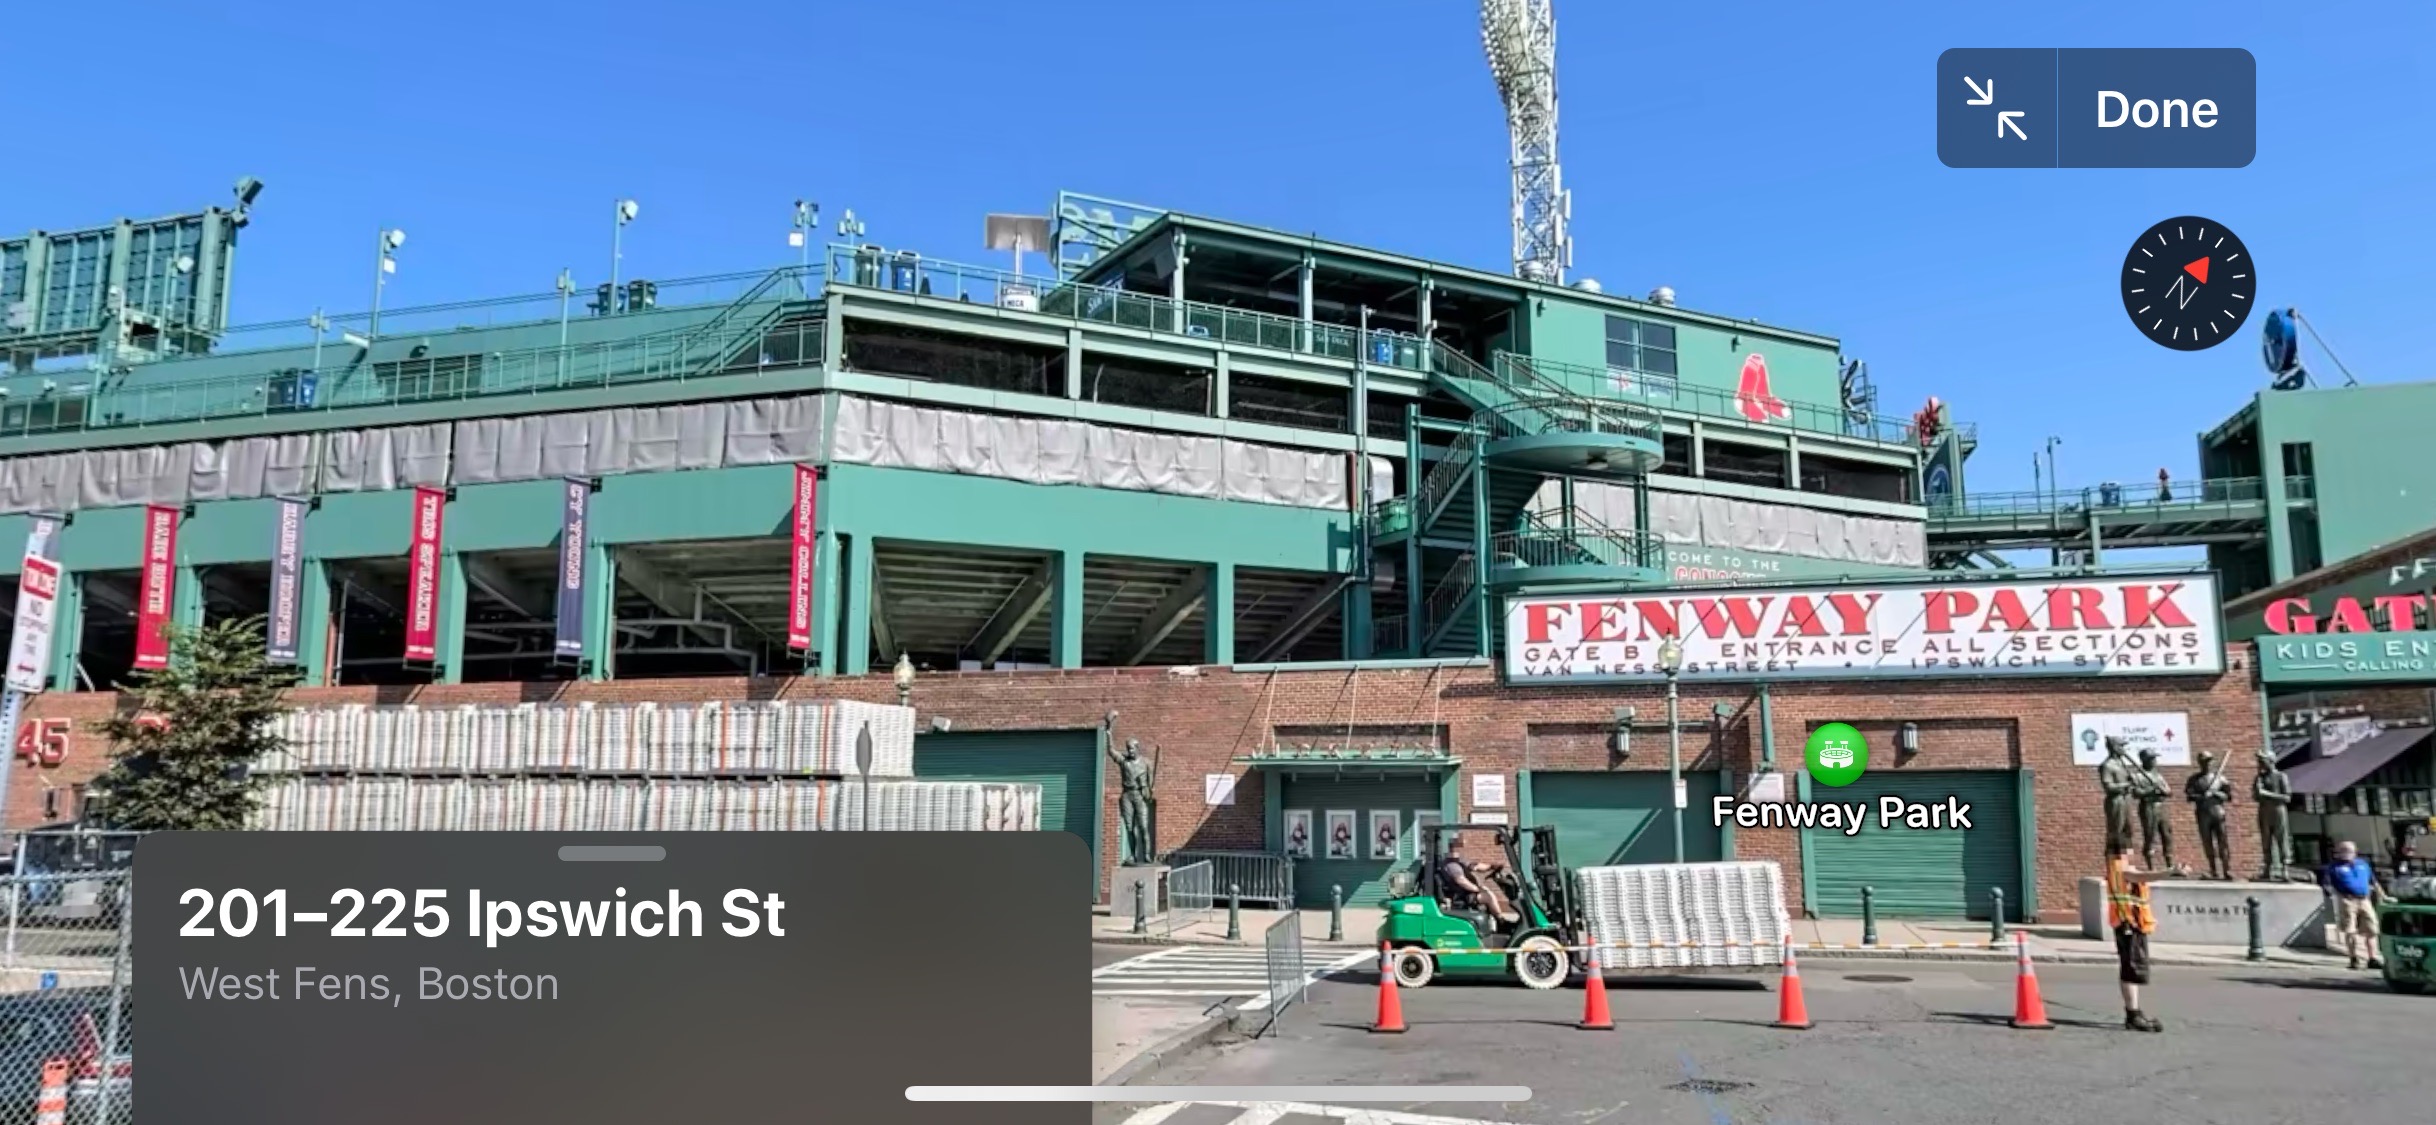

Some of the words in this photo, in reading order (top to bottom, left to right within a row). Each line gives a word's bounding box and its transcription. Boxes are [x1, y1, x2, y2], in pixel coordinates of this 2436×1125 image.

[1722, 556, 1742, 567] TO
[1752, 559, 1781, 572] THE
[1524, 592, 1884, 644] FENWAY
[1921, 583, 2197, 634] PARK
[2264, 593, 2436, 635] GAT
[1525, 646, 1601, 662] GATE
[1625, 645, 1640, 660] B
[1721, 639, 1898, 658] ENTRANCE
[1922, 637, 1985, 654] ALL
[2011, 632, 2199, 652] SECTIONS
[2276, 642, 2359, 660] KIDS
[2385, 640, 2436, 657] EN
[1525, 665, 1573, 677] VAN
[1595, 663, 1663, 675] NESS
[1688, 660, 1799, 674] STREET
[1911, 655, 2048, 670] IPSWICH
[2074, 651, 2201, 666] STREET
[2344, 659, 2424, 672] CALLING
[17, 717, 71, 764] 45
[2166, 904, 2251, 916] TEAMMATE
